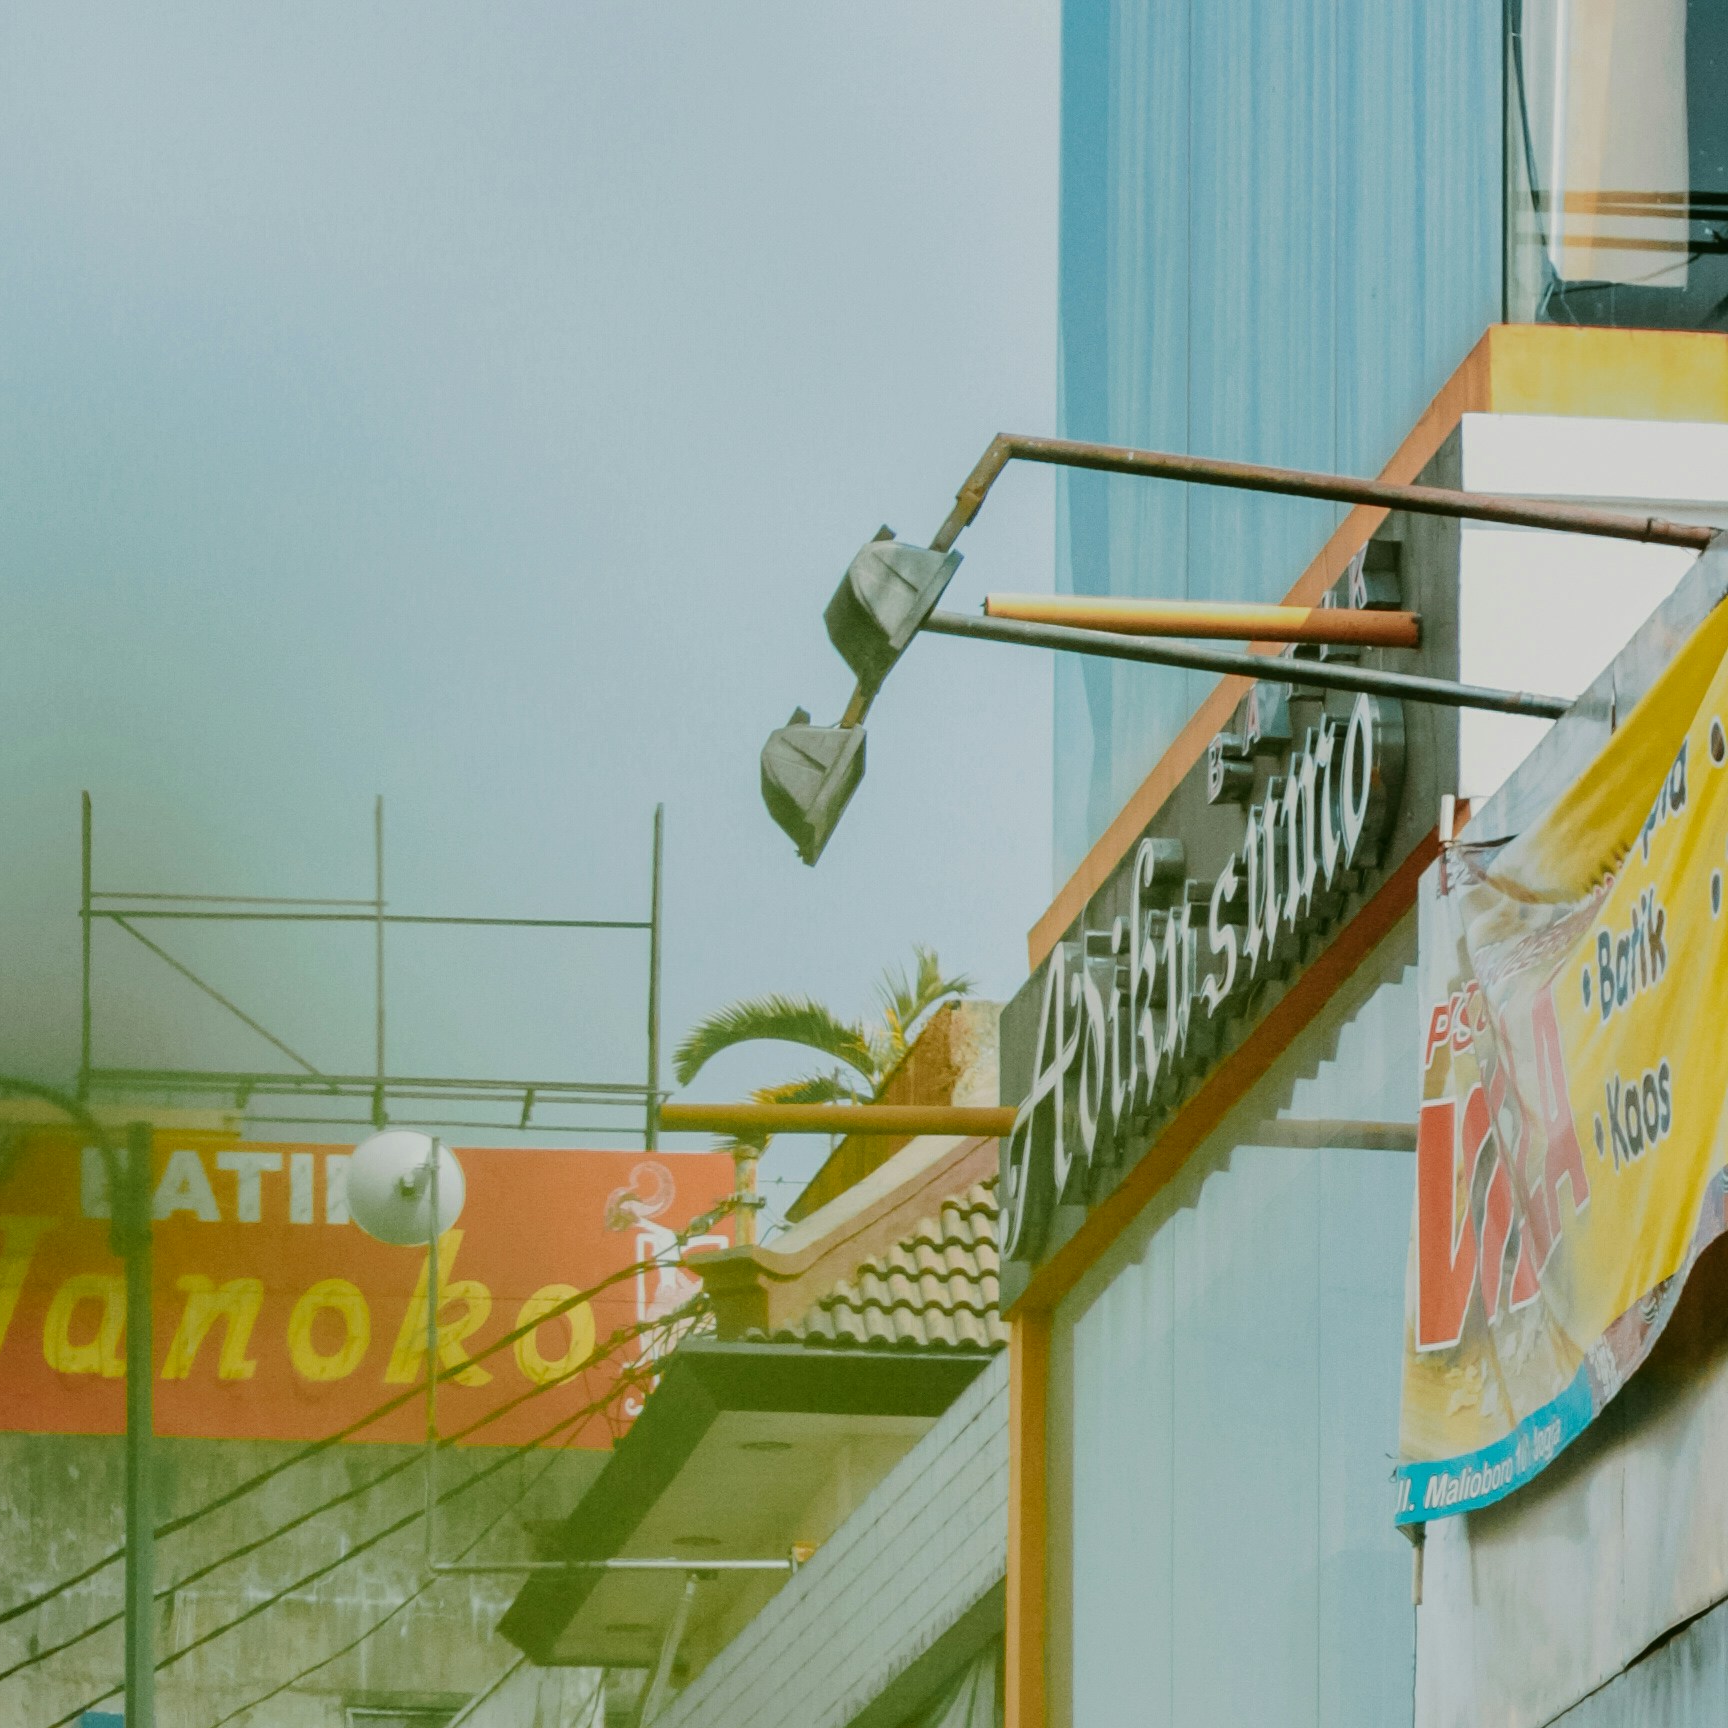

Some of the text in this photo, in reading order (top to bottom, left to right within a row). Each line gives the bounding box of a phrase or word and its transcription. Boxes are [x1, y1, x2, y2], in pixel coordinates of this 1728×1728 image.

[1208, 542, 1369, 804] BAK
[1599, 889, 1667, 1020] Batik
[1606, 1060, 1670, 1172] Kaos
